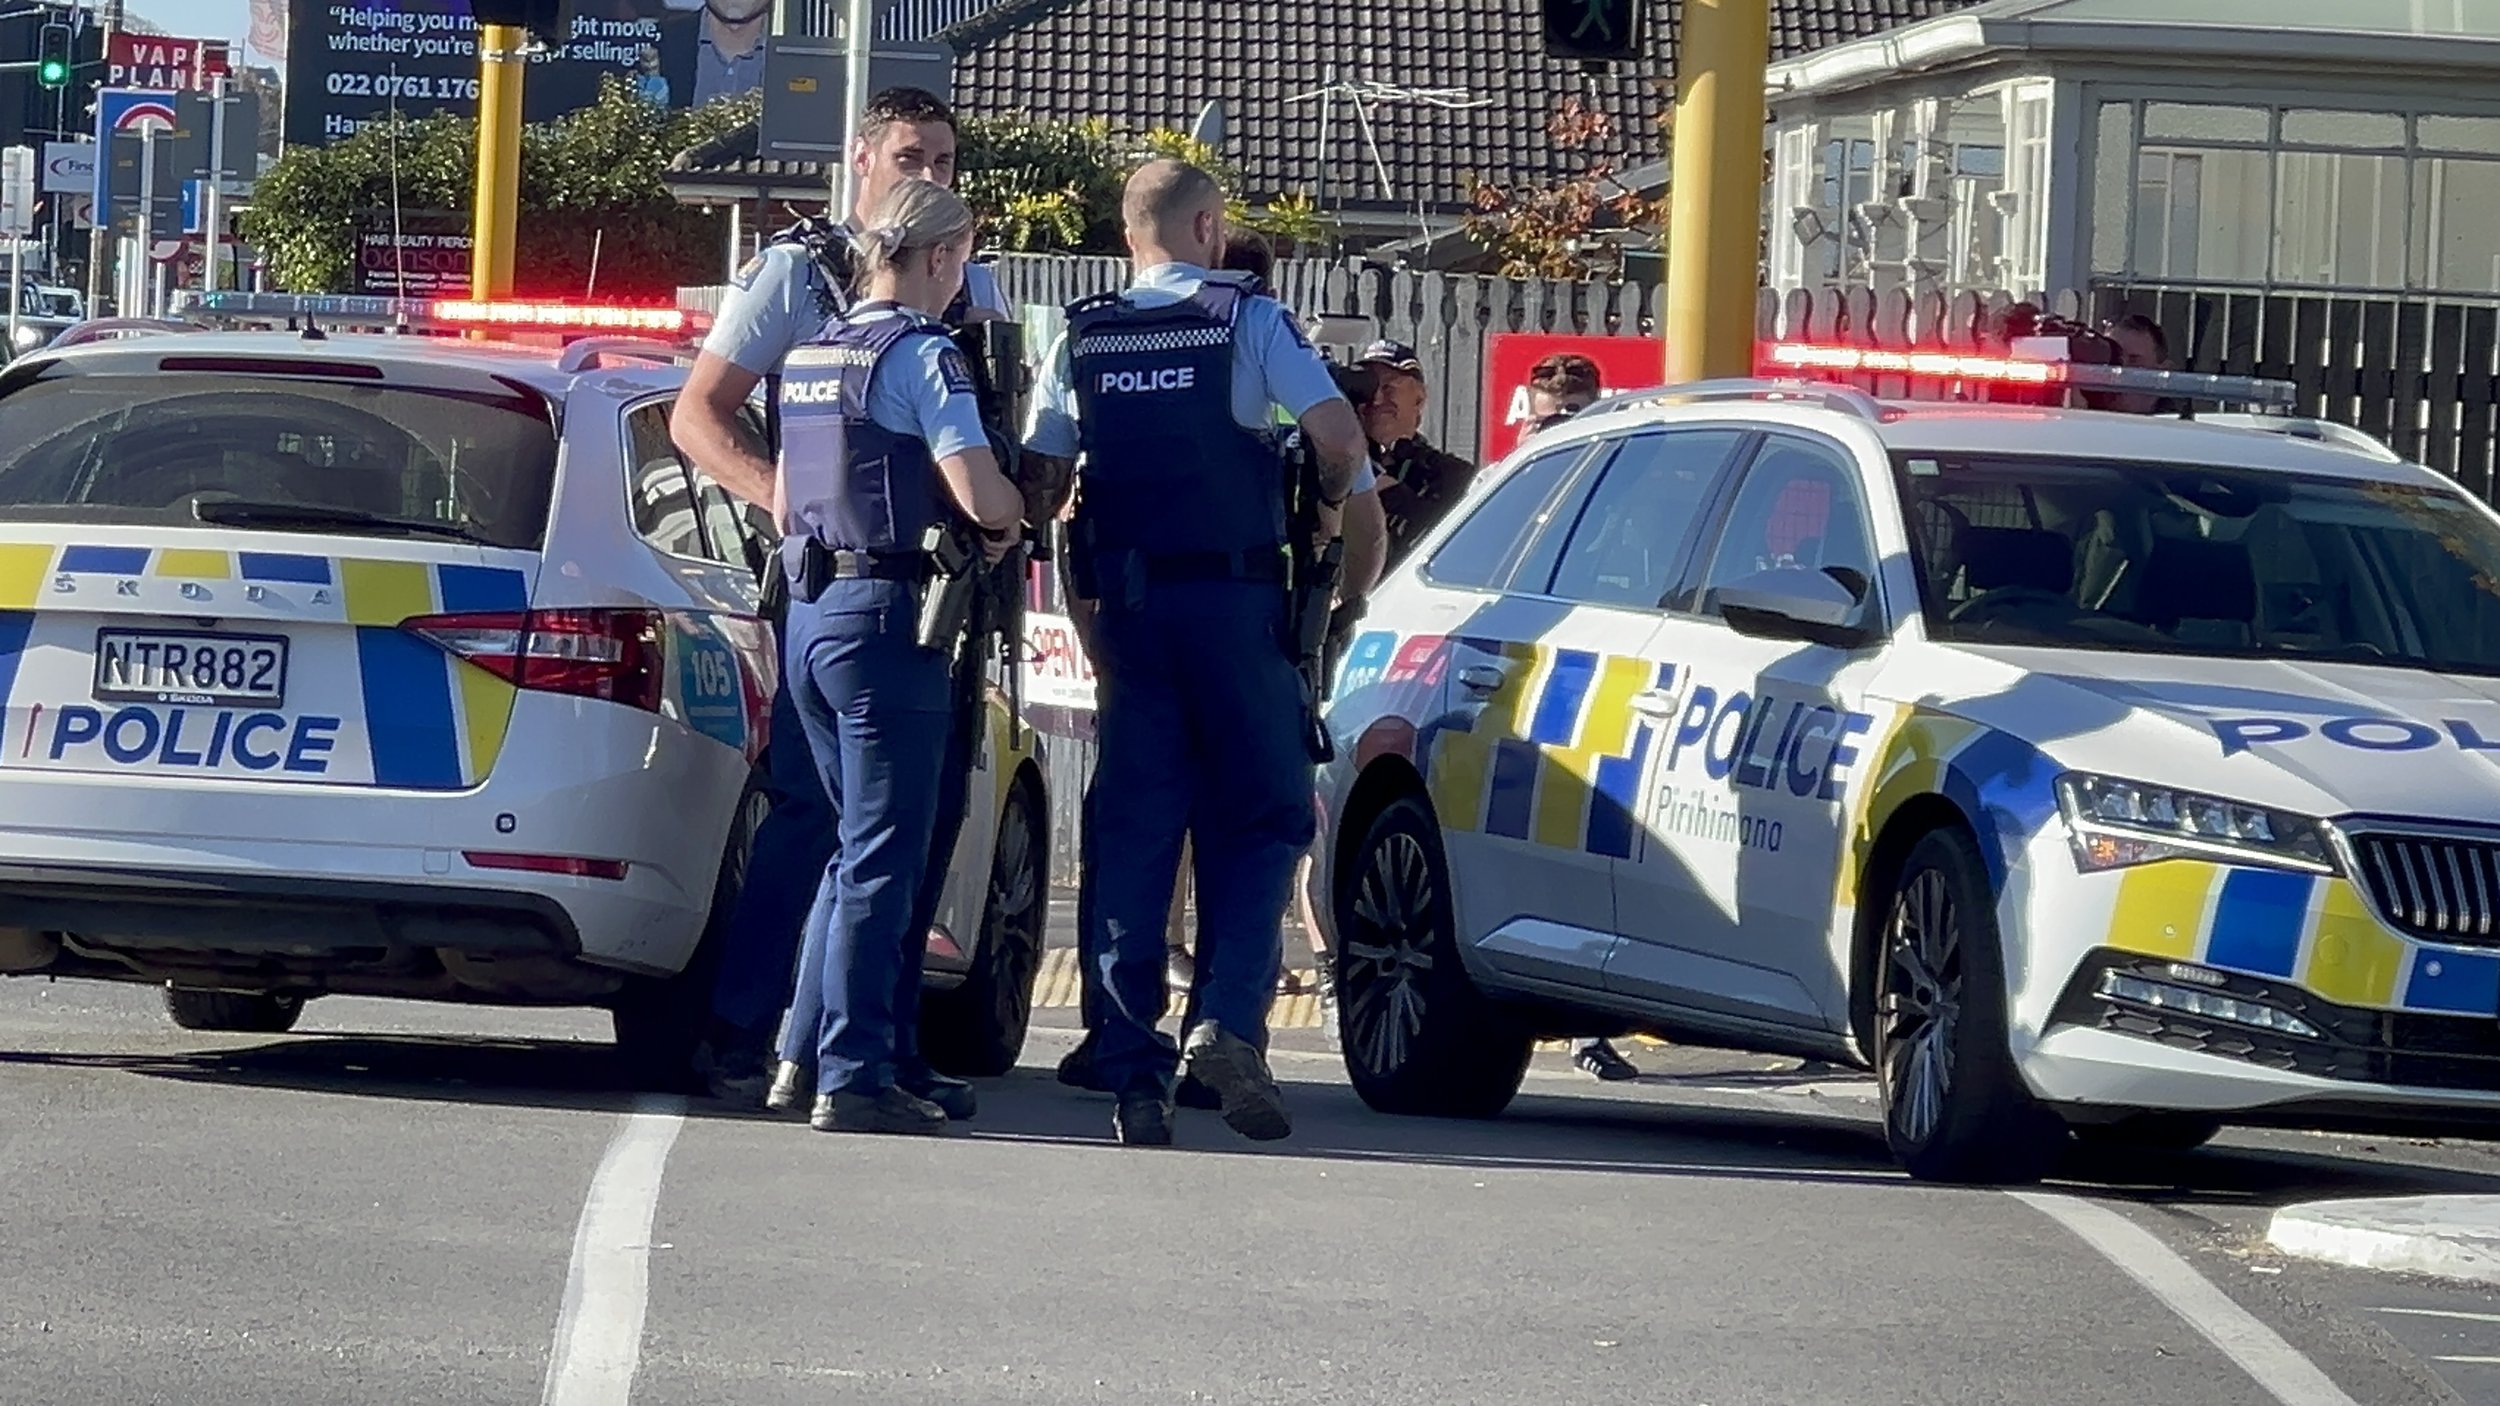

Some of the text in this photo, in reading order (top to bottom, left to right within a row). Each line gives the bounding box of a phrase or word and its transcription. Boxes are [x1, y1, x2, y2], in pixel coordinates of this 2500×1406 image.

[417, 14, 454, 33] you
[571, 15, 661, 41] ght move,
[328, 31, 474, 58] whether you're
[326, 73, 481, 100] 022 0761 176
[783, 379, 841, 404] POLICE
[1100, 366, 1195, 394] POLICE
[102, 640, 277, 692] NTR882
[691, 649, 732, 697] 105
[49, 704, 341, 774] POLICE
[1668, 683, 1876, 800] POLICE
[1656, 783, 1783, 852] Pirihimana
